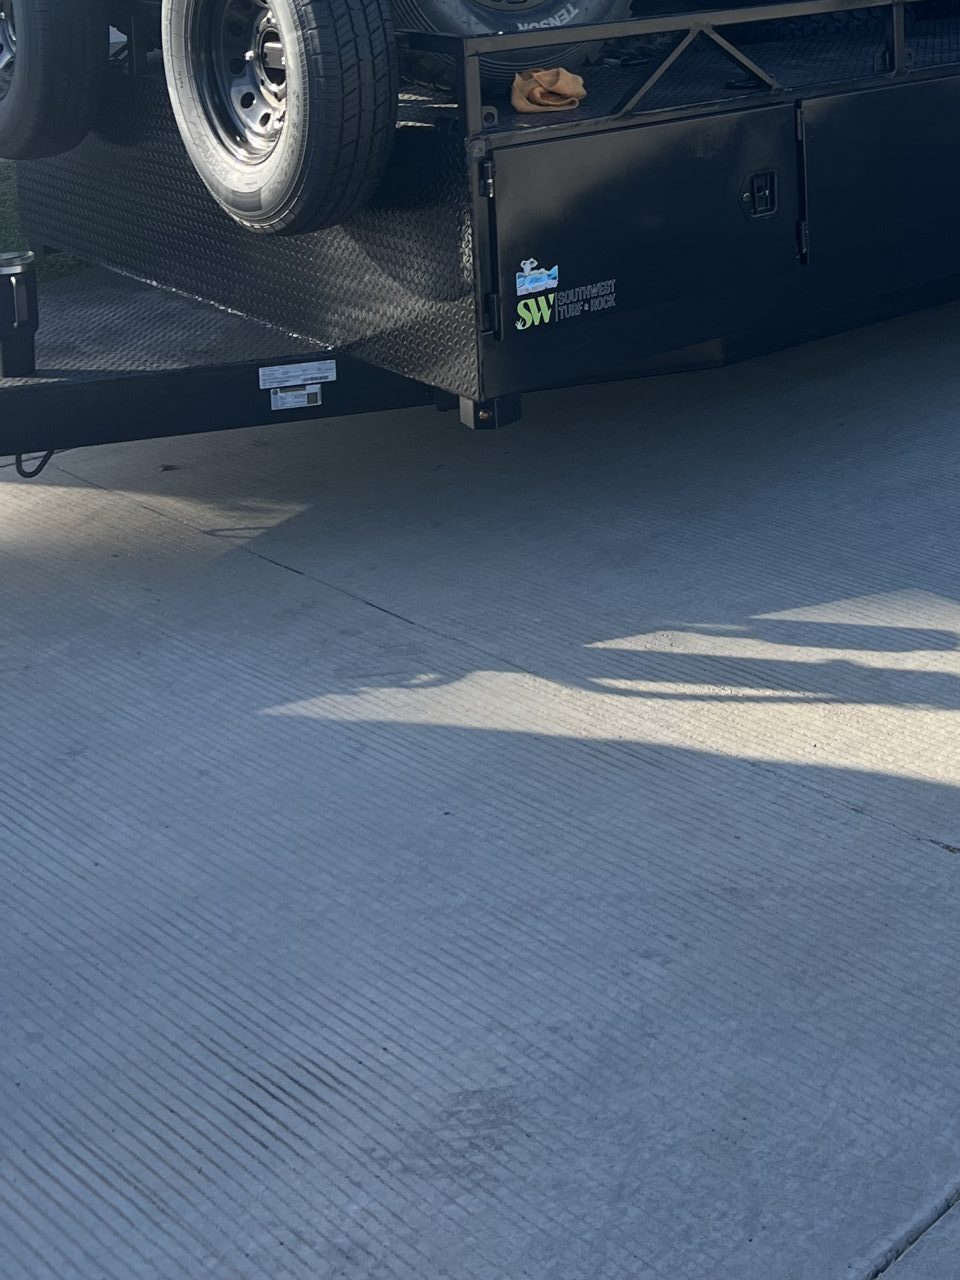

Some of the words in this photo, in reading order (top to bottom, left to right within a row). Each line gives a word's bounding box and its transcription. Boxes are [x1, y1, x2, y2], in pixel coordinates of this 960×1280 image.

[558, 279, 616, 306] SOUTHWEST
[515, 293, 555, 330] SW
[559, 301, 583, 320] TURF
[590, 293, 616, 312] ROCK
